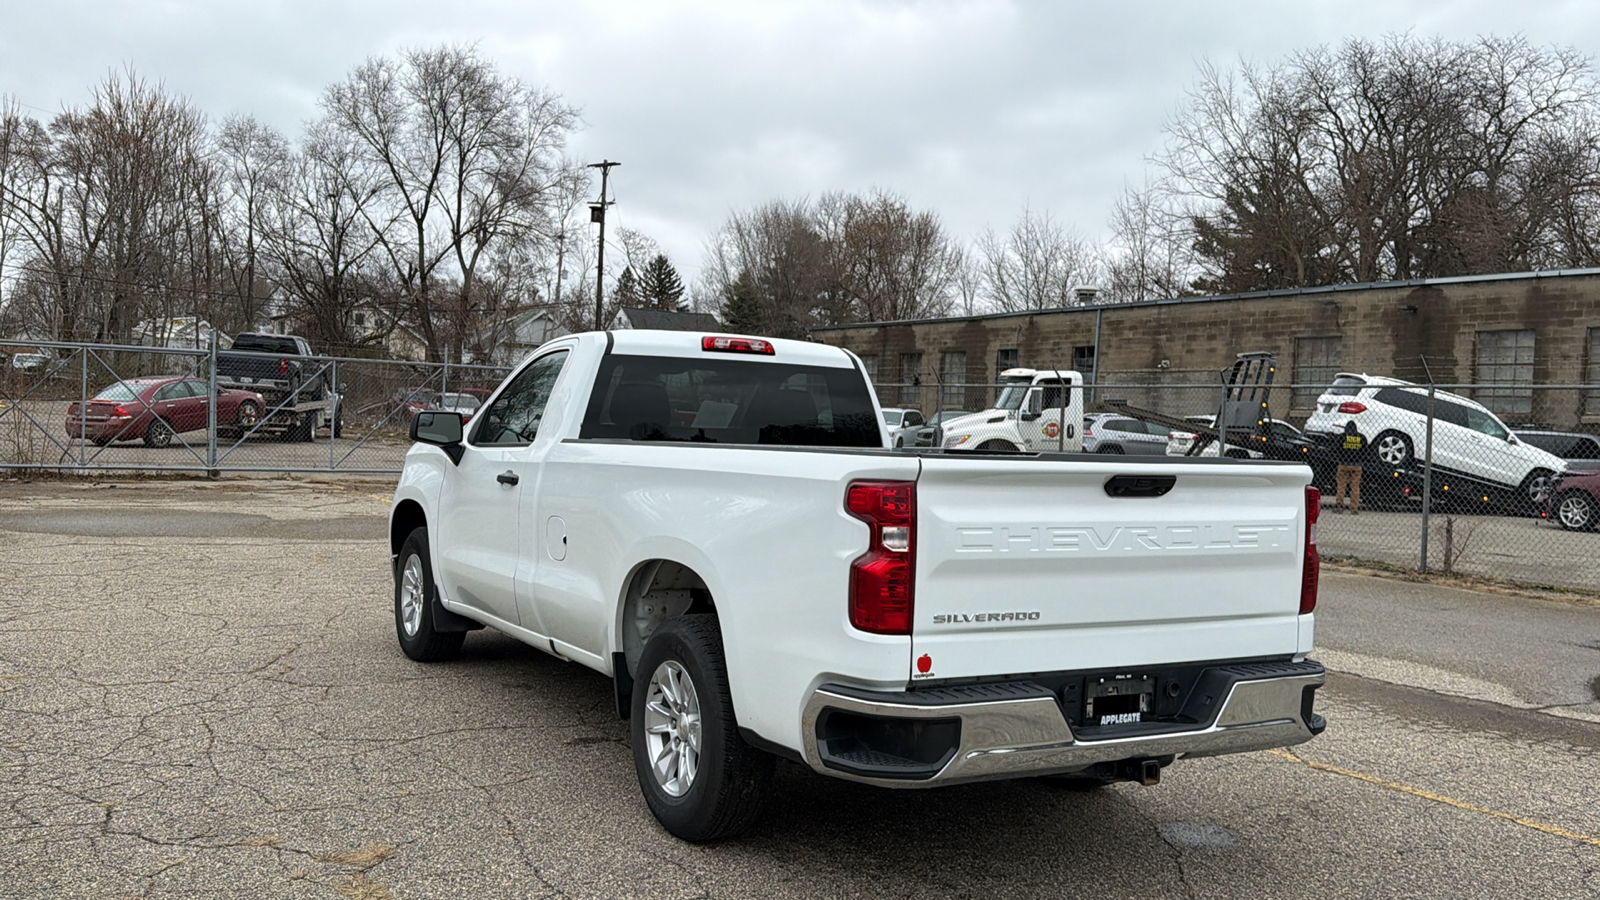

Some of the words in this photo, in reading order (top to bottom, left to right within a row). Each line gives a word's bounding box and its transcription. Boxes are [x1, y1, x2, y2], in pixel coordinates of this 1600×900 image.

[955, 524, 1290, 552] CHEVROLET
[933, 611, 1041, 624] SILVERADO
[1100, 712, 1141, 726] APPLEGATE
